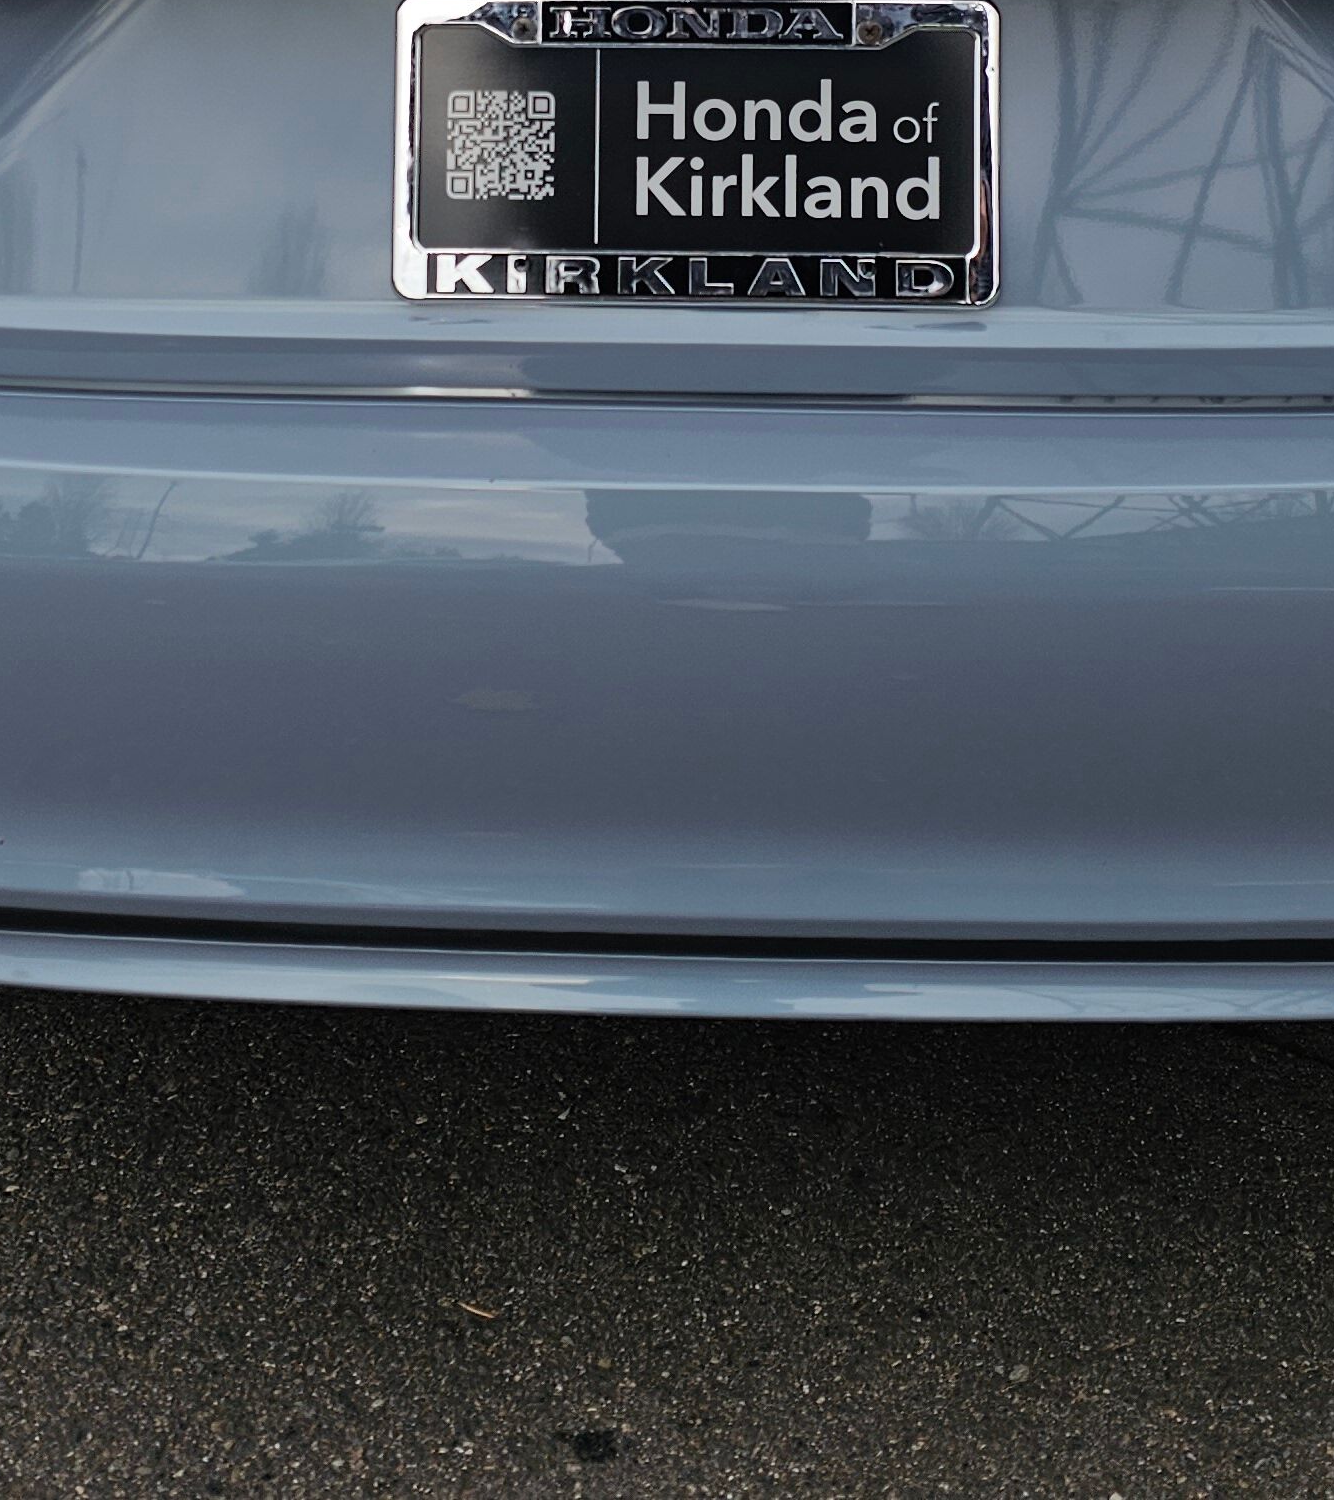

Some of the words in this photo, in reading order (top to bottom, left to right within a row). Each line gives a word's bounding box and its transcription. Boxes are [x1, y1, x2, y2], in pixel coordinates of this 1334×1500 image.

[549, 5, 844, 40] HONDA
[636, 78, 877, 143] Honda
[893, 102, 940, 143] of
[635, 153, 941, 221] Kirkland
[435, 255, 955, 297] KIRKLAND
